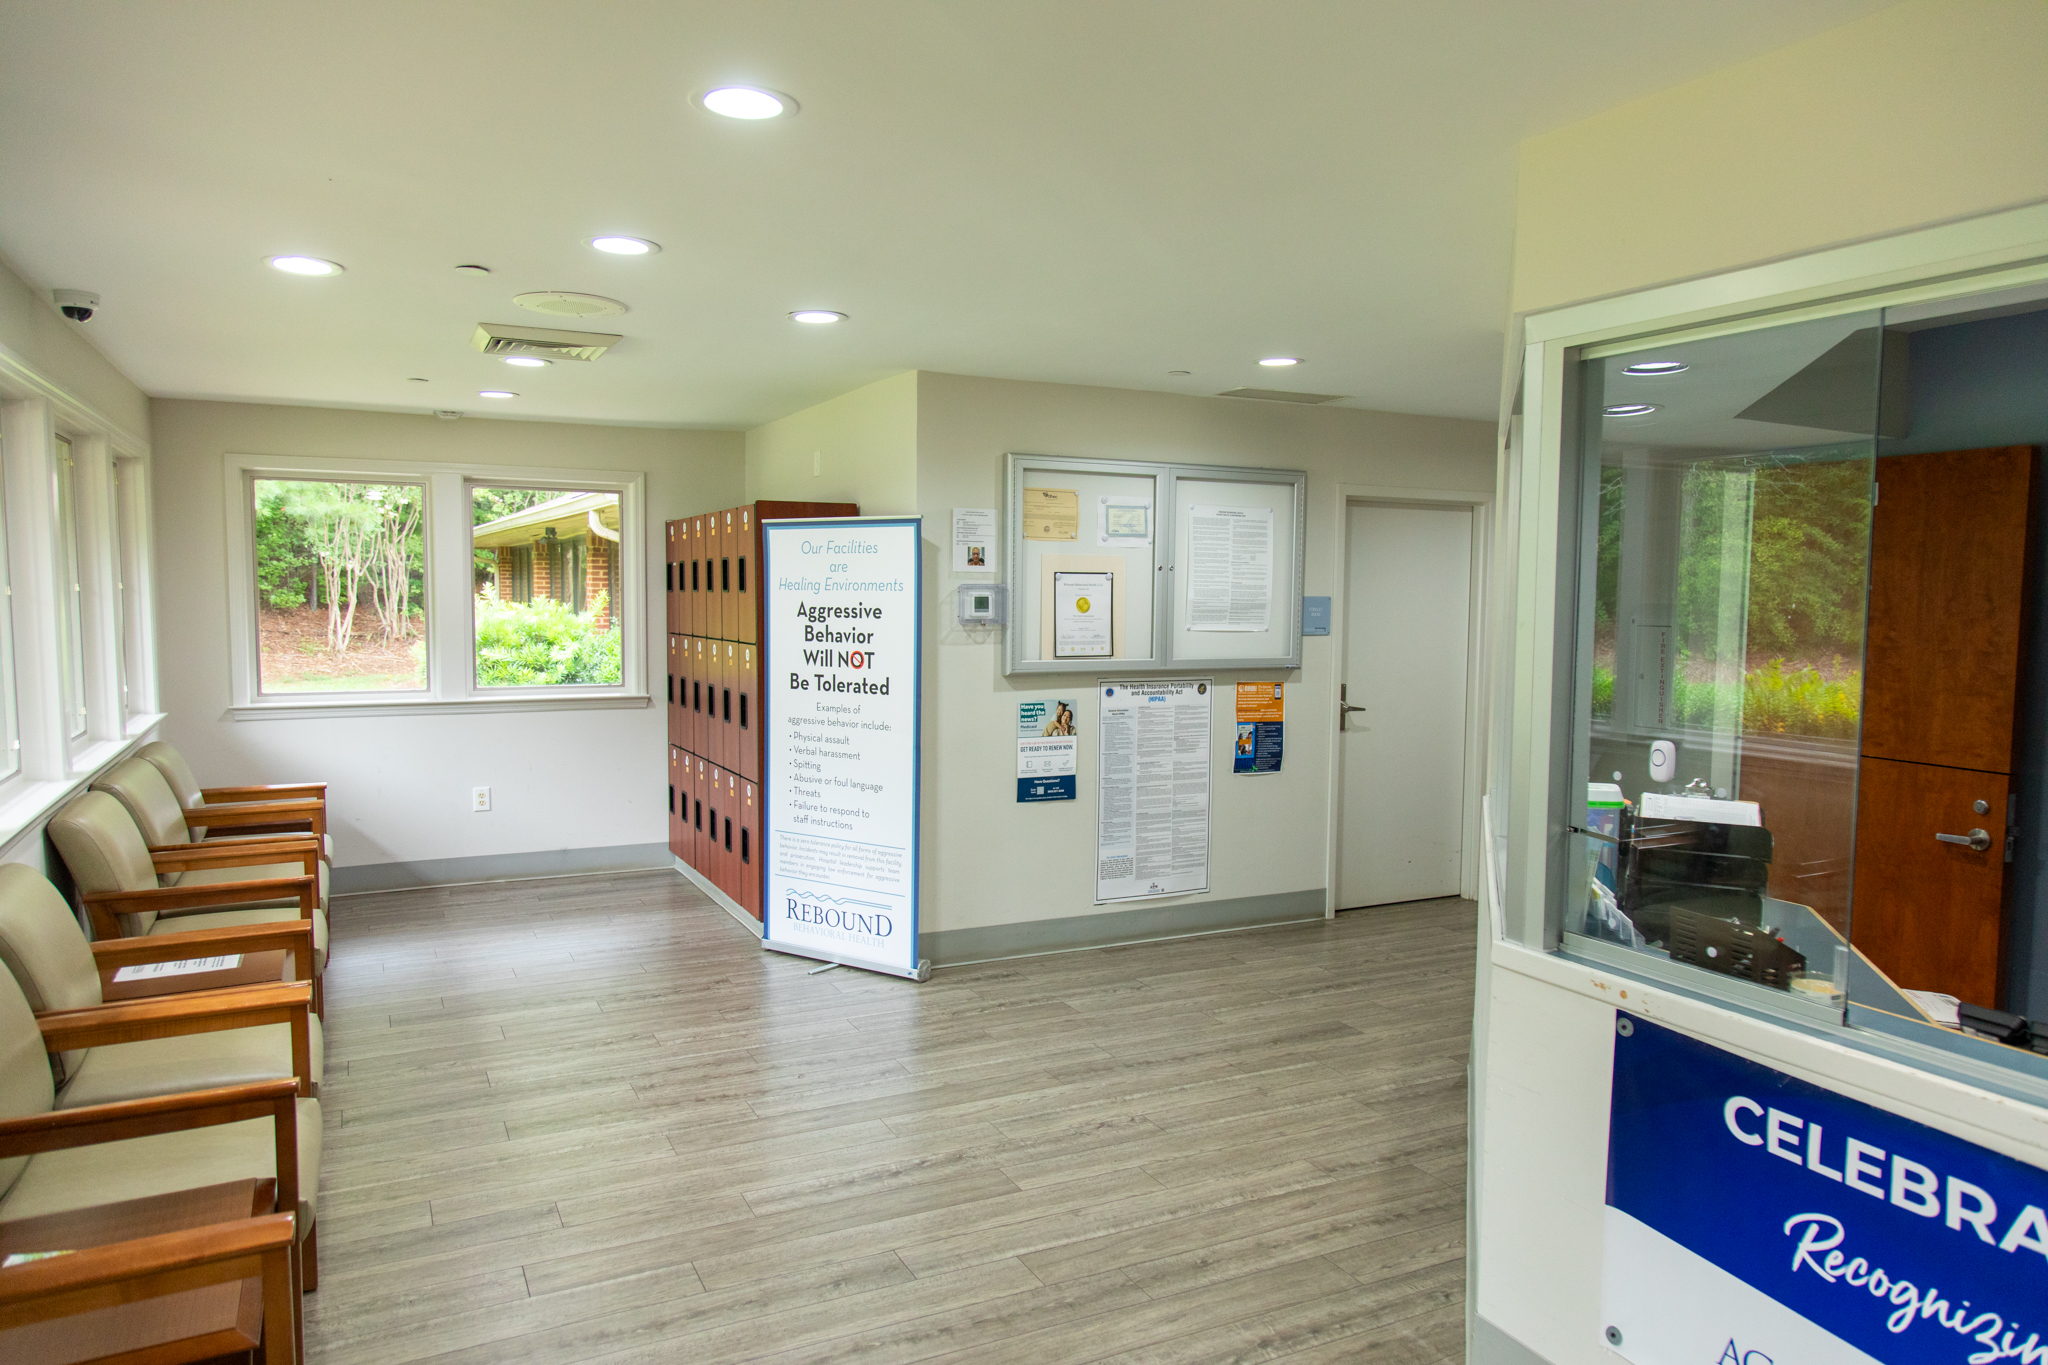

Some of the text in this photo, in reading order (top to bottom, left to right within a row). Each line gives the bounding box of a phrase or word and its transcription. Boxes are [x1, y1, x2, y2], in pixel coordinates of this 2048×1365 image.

[801, 540, 878, 554] Our Facilities
[830, 563, 848, 573] are
[779, 577, 904, 594] Healing Environments
[797, 601, 882, 623] Aggressive
[805, 625, 874, 644] Behavior
[803, 649, 875, 669] Will NOT
[790, 673, 889, 695] Be Tolerated
[817, 702, 861, 714] Examples of
[788, 716, 892, 731] aggressive behavior include:
[794, 731, 849, 745] Physical assault
[794, 745, 861, 760] Verbal harassment
[794, 759, 821, 772] Spitting
[794, 773, 822, 784] Abusive
[834, 777, 848, 787] foul
[850, 779, 883, 793] language
[794, 786, 821, 798] Threats
[794, 800, 870, 818] Failure to respond to
[793, 815, 853, 830] staff instructions
[786, 898, 892, 937] REBOUND
[793, 922, 884, 948] BEHAVIORAL HEALTH
[1723, 1095, 2048, 1260] CELEBRA
